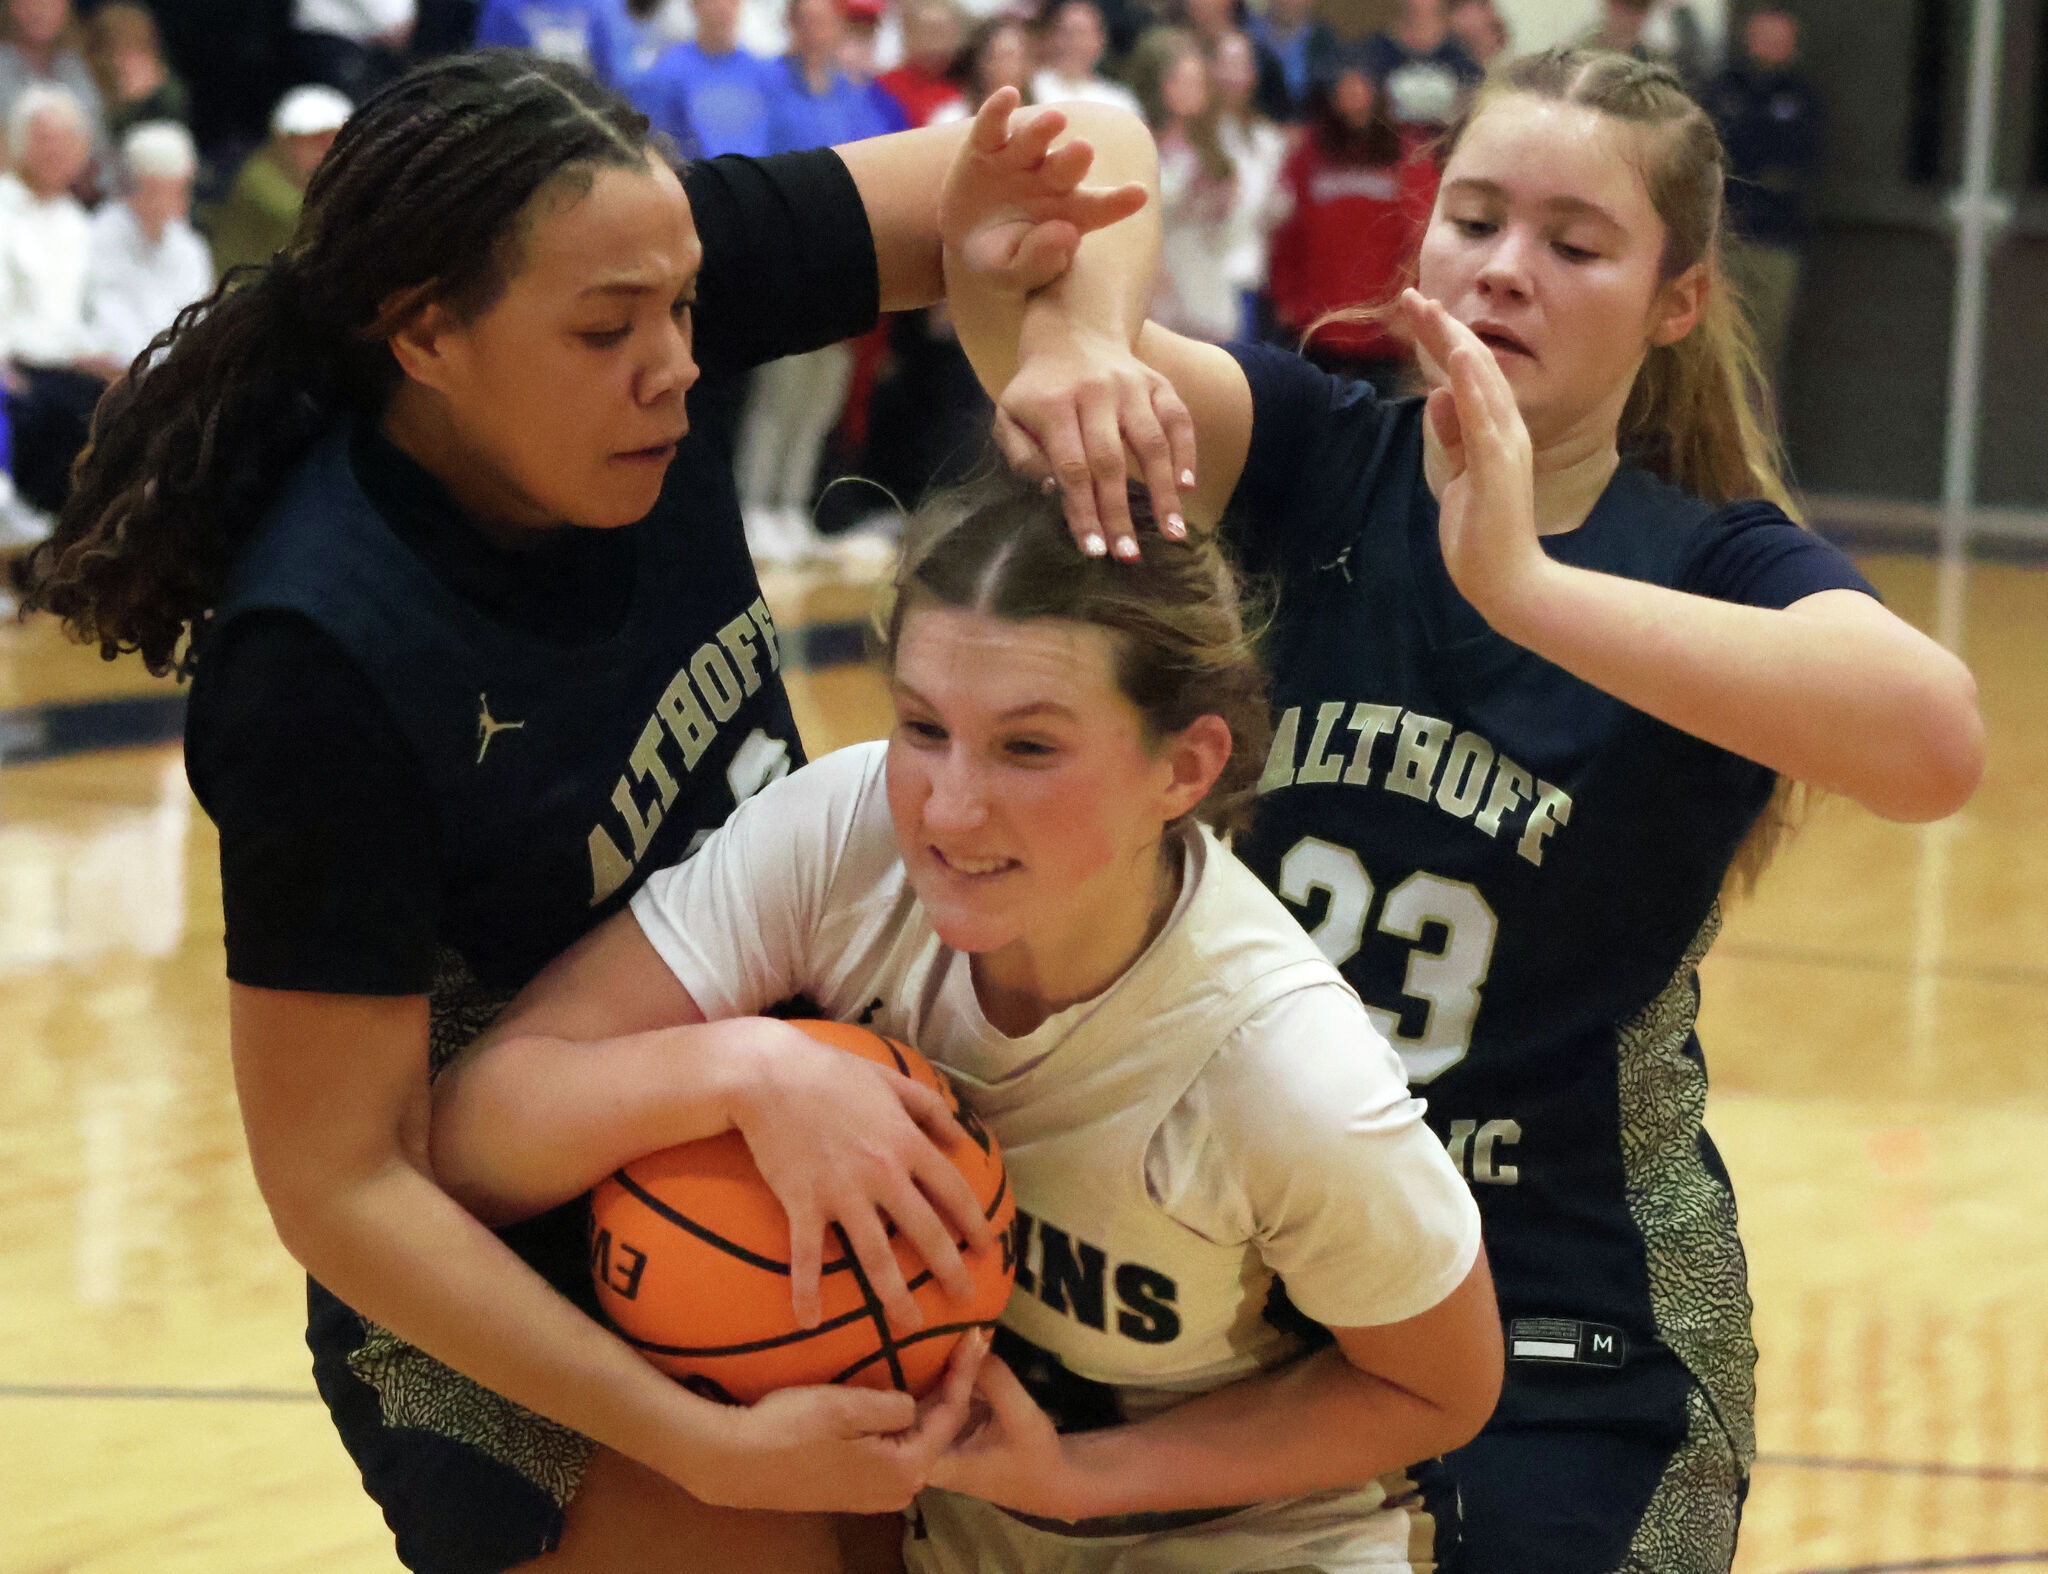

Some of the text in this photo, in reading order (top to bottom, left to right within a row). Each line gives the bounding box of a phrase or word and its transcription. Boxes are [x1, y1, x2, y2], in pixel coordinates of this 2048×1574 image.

[588, 596, 779, 907] ALTHOFF
[1257, 702, 1573, 867] ALTHOFF
[1279, 836, 1498, 1085] 23
[1593, 1333, 1613, 1353] M
